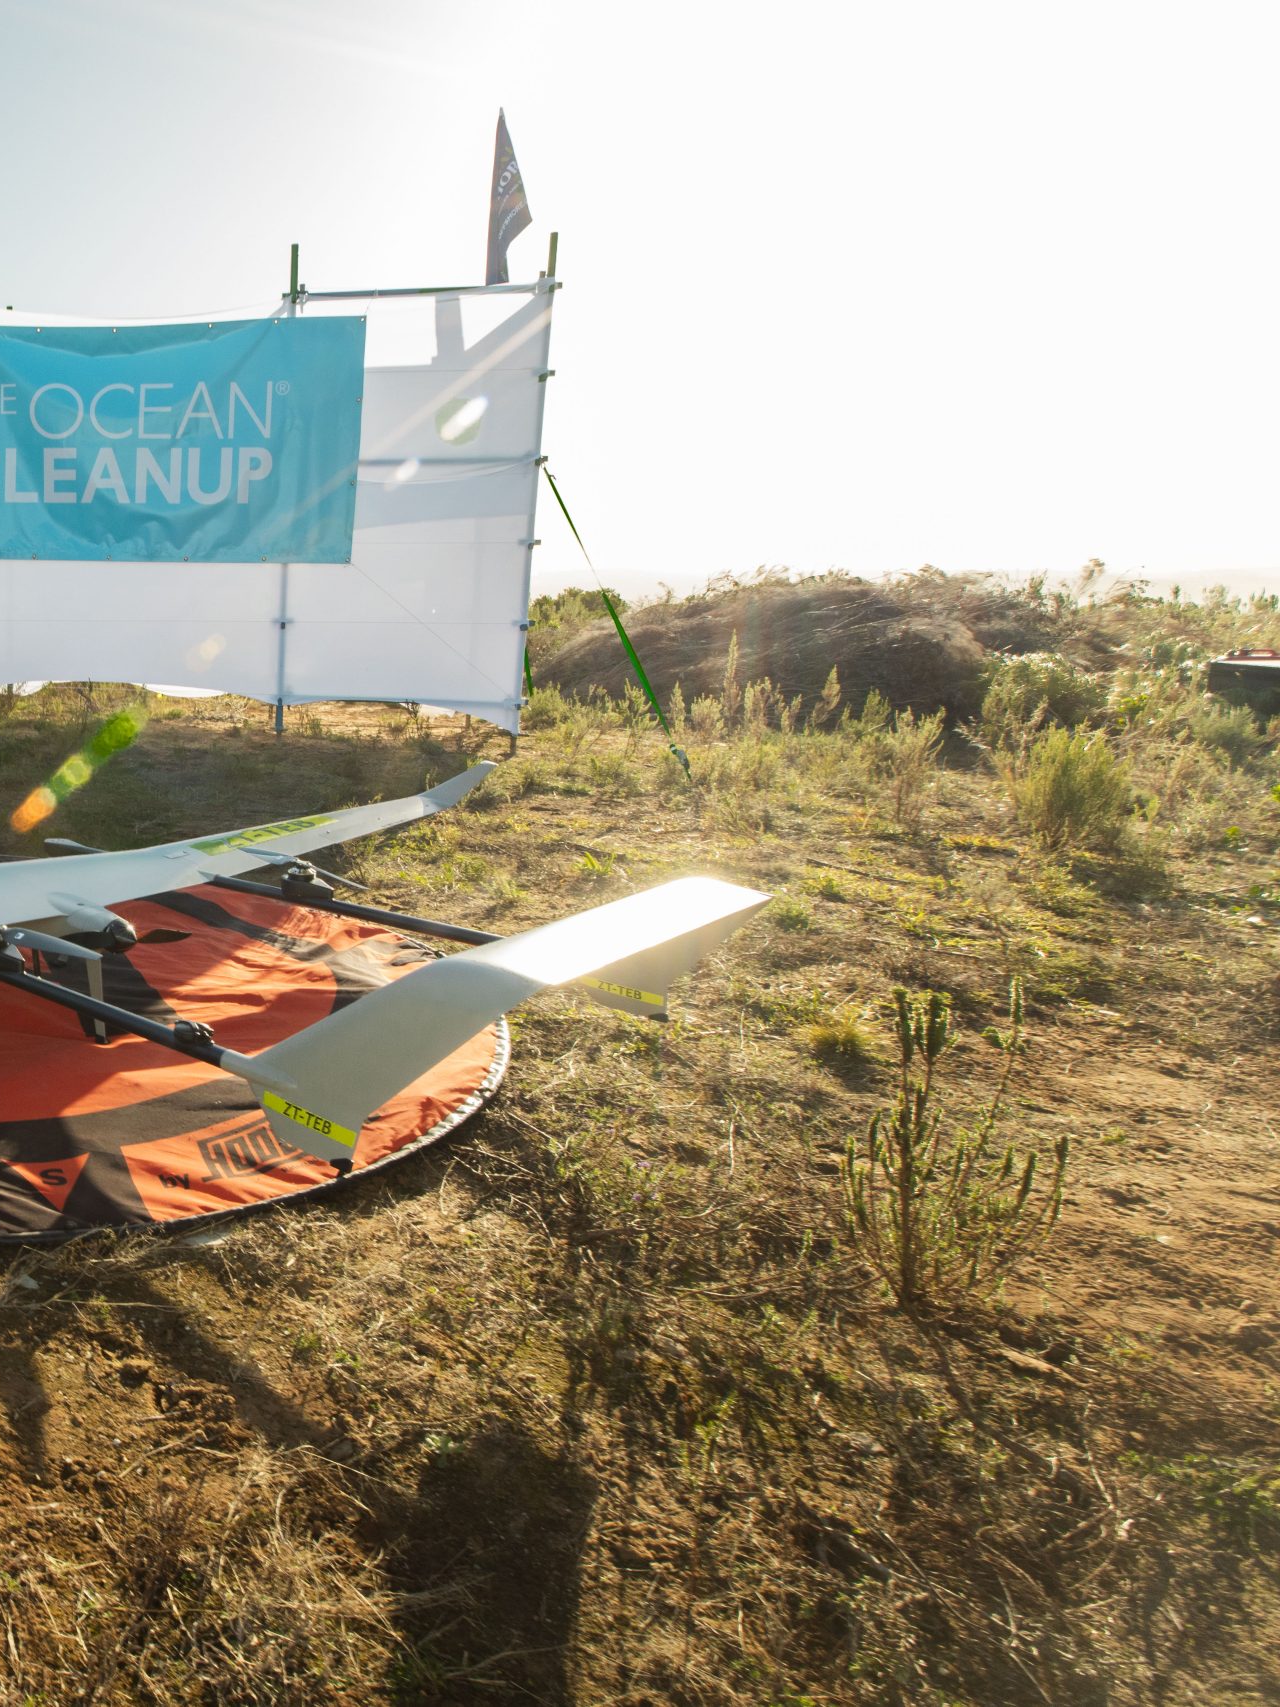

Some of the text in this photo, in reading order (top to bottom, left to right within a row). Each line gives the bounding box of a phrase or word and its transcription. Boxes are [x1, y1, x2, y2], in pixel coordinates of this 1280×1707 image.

[597, 980, 642, 1000] ZT-TEB
[283, 1101, 332, 1135] ZT-TEB
[39, 1168, 68, 1186] S
[158, 1172, 190, 1190] by
